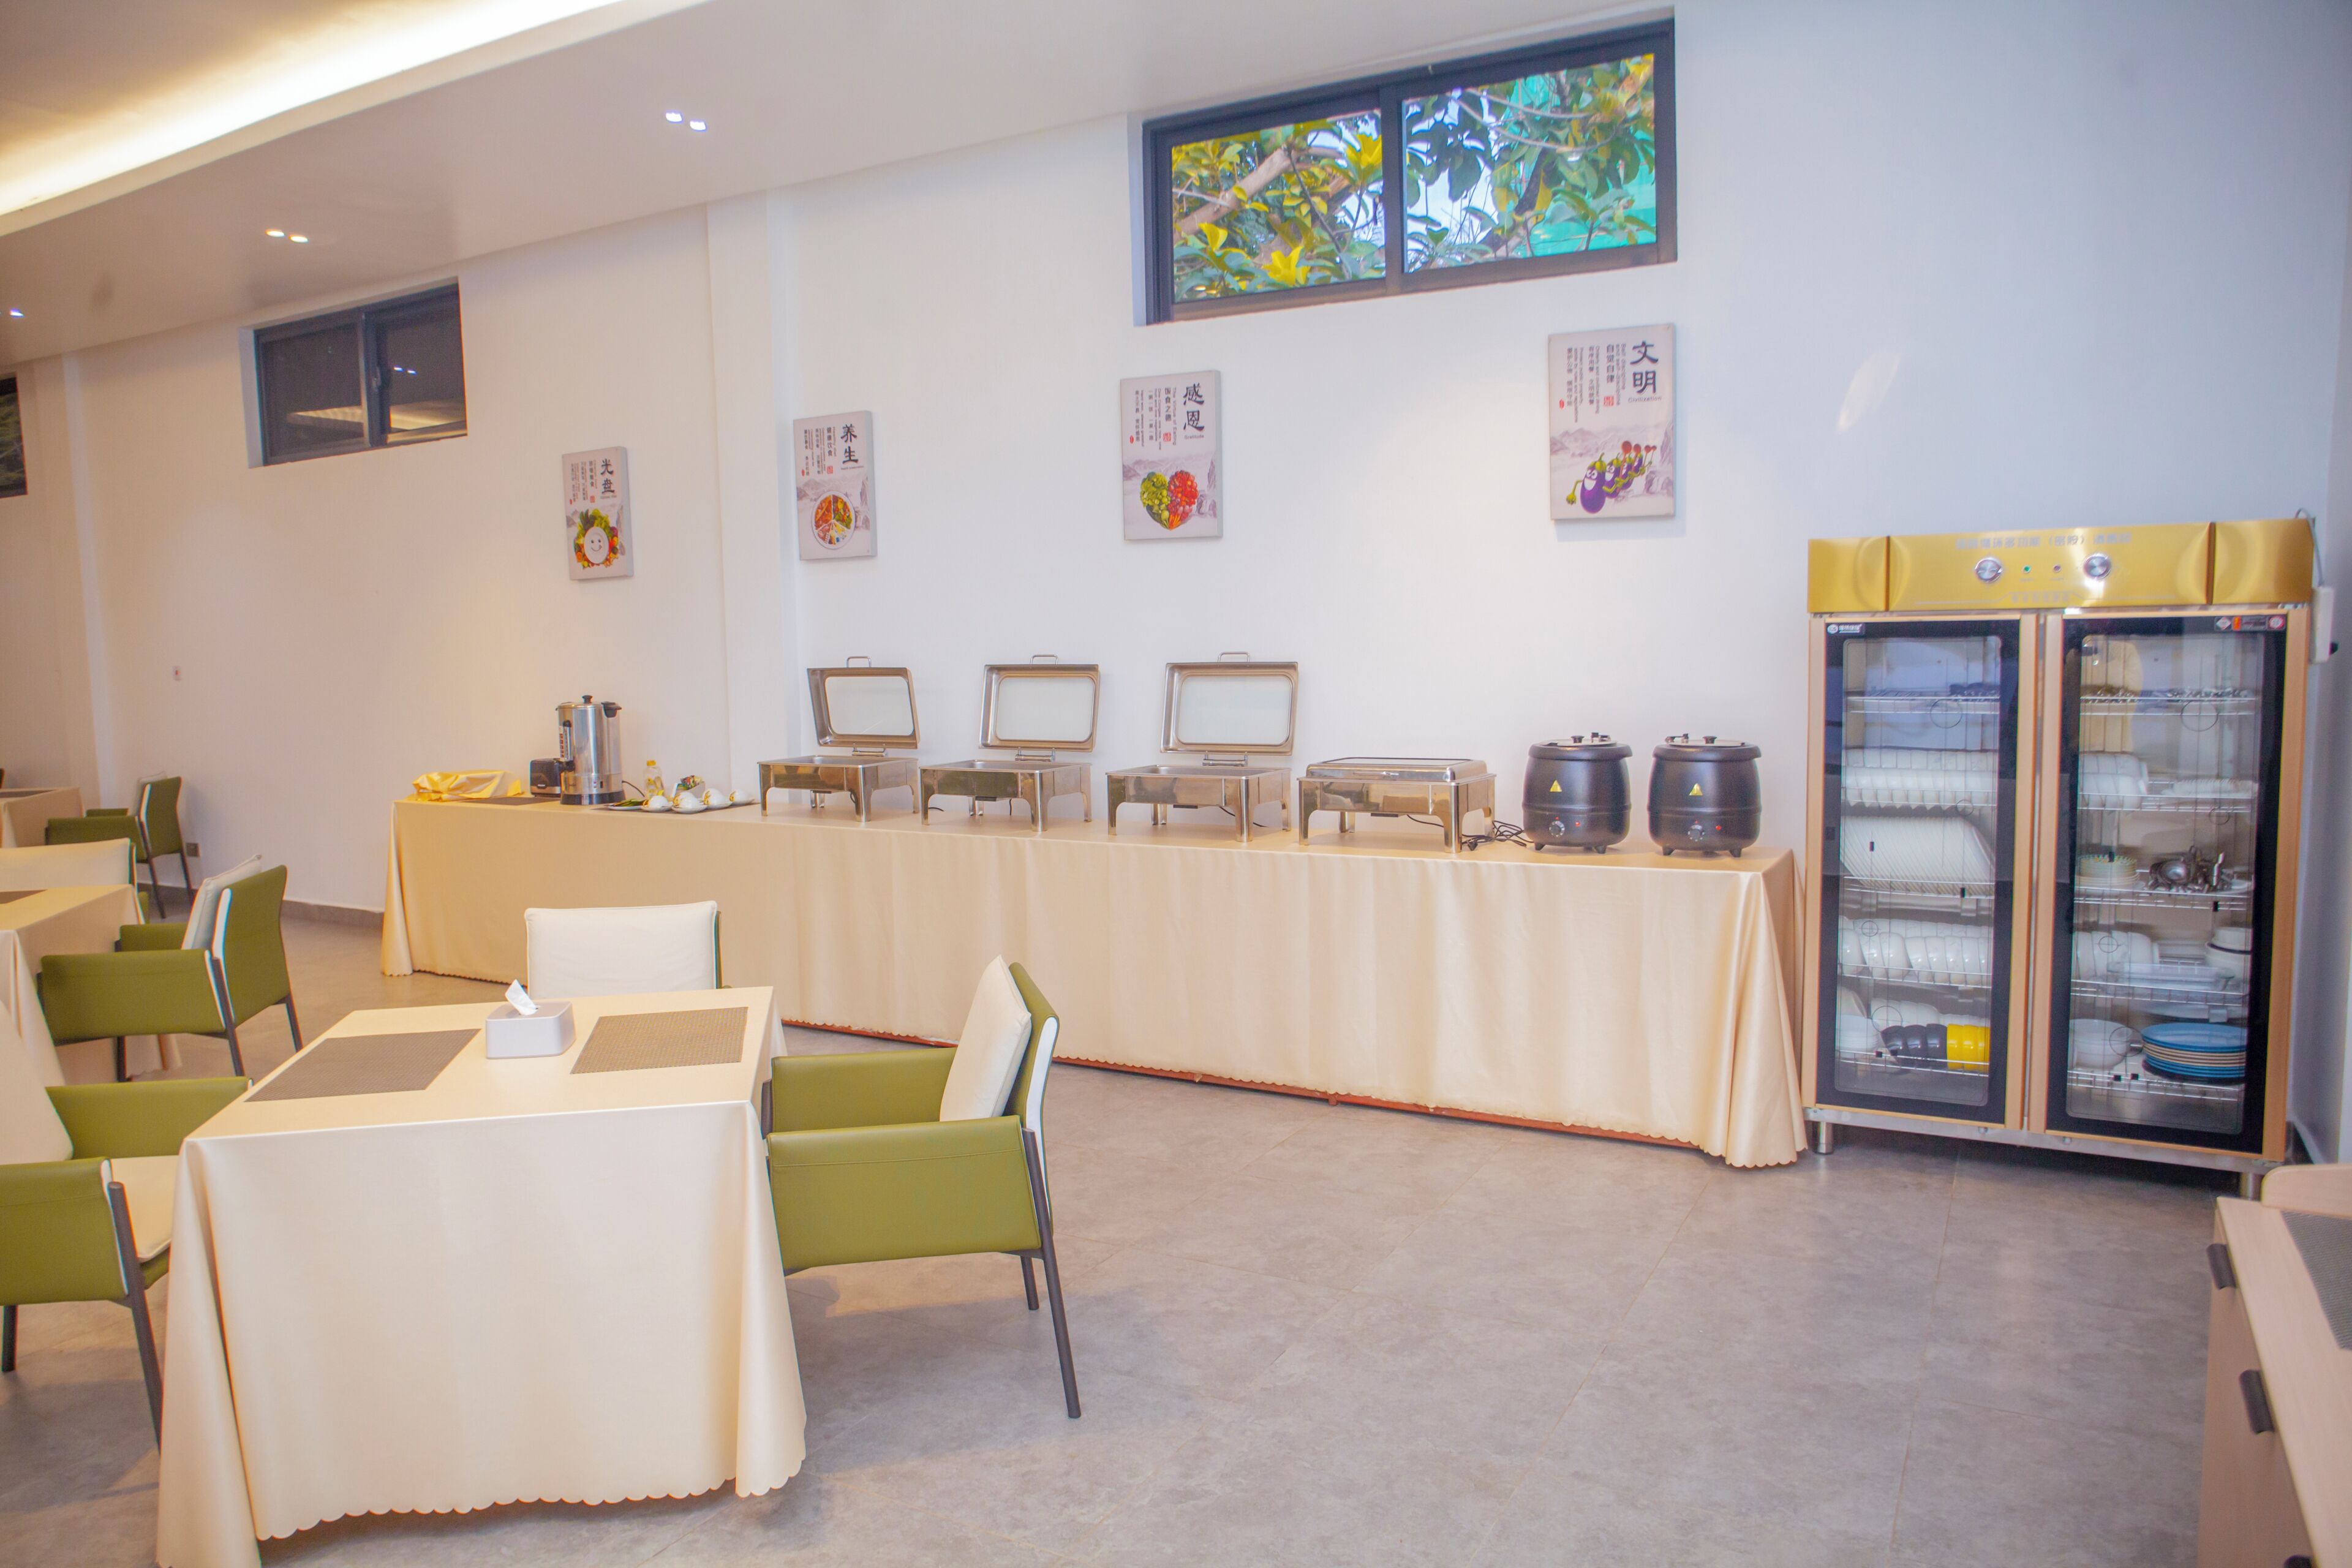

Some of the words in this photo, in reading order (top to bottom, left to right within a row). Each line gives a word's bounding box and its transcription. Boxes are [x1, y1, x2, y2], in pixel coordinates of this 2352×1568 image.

[1629, 340, 1659, 394] 文明
[1183, 382, 1205, 431] 感恩
[840, 423, 858, 464] 养生
[600, 458, 615, 494] 光盘
